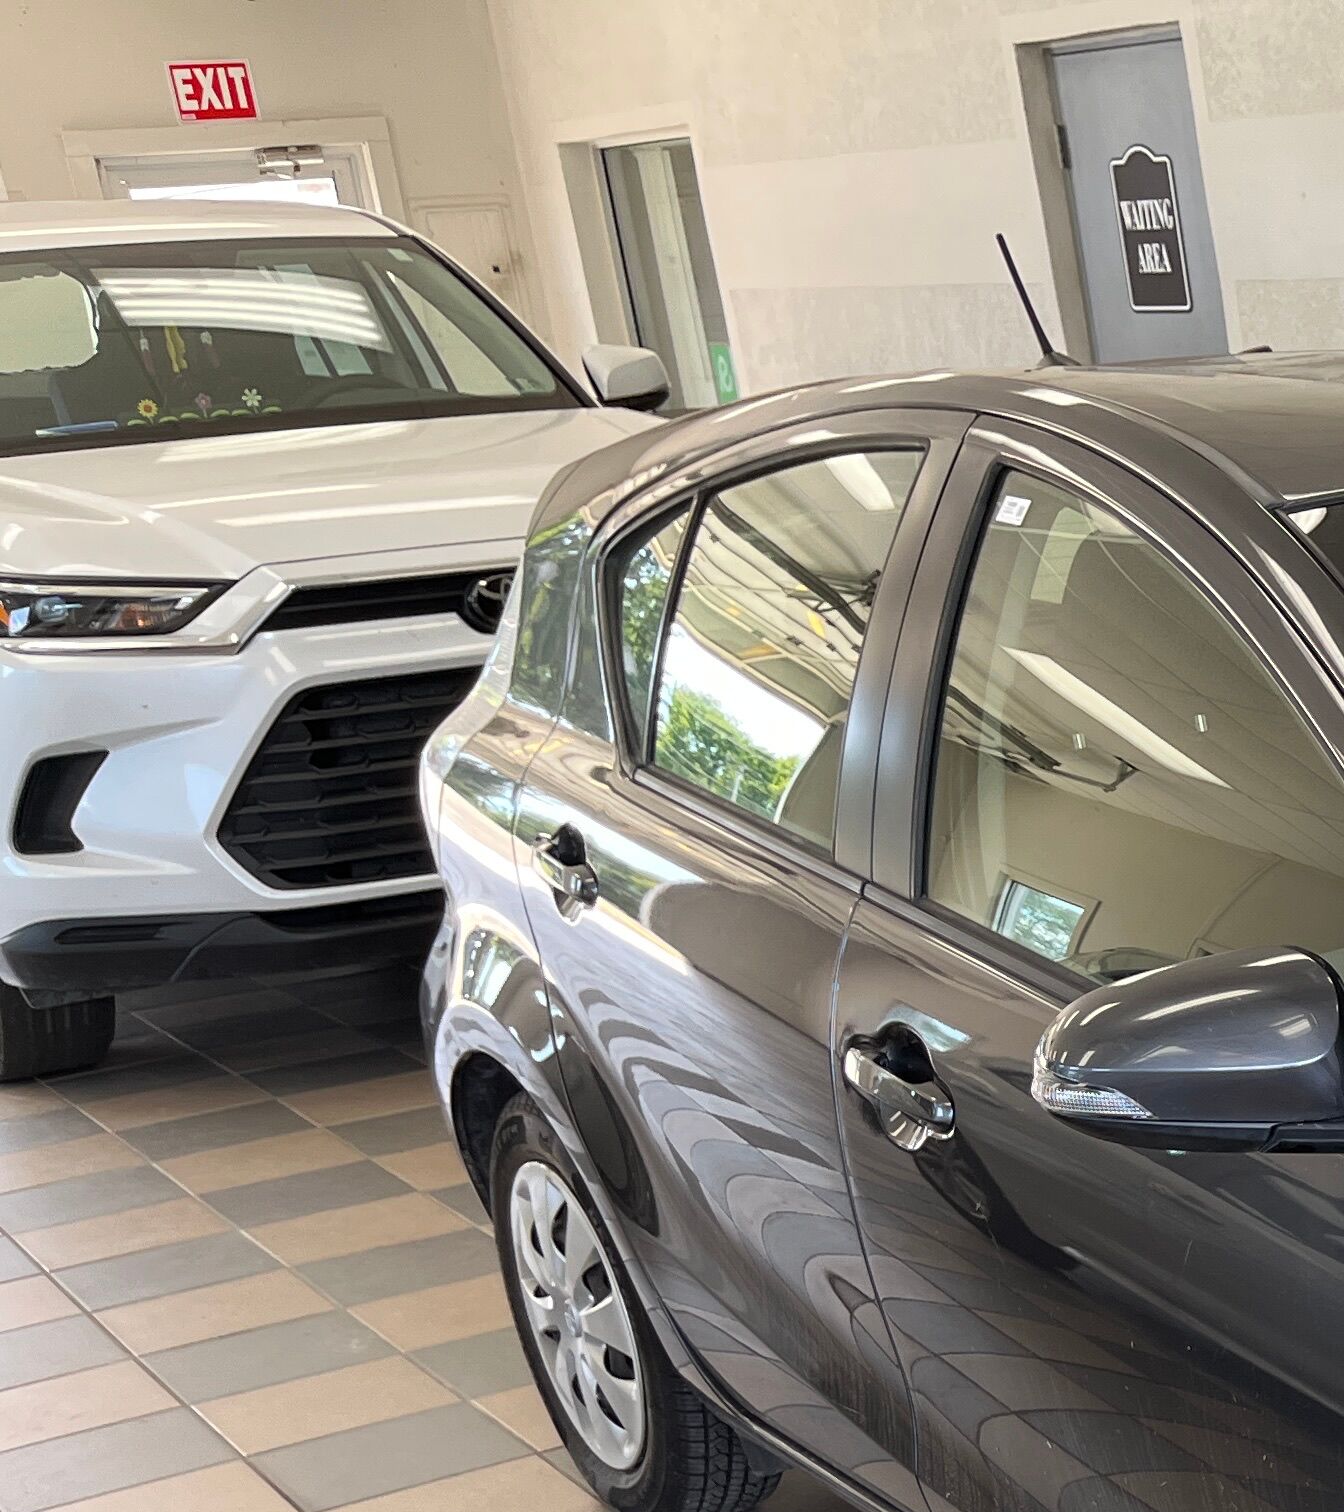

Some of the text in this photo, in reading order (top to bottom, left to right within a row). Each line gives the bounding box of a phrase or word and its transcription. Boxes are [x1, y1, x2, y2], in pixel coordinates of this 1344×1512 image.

[171, 66, 249, 111] EXIT
[1120, 198, 1174, 230] WAITING
[1138, 243, 1172, 273] AREA
